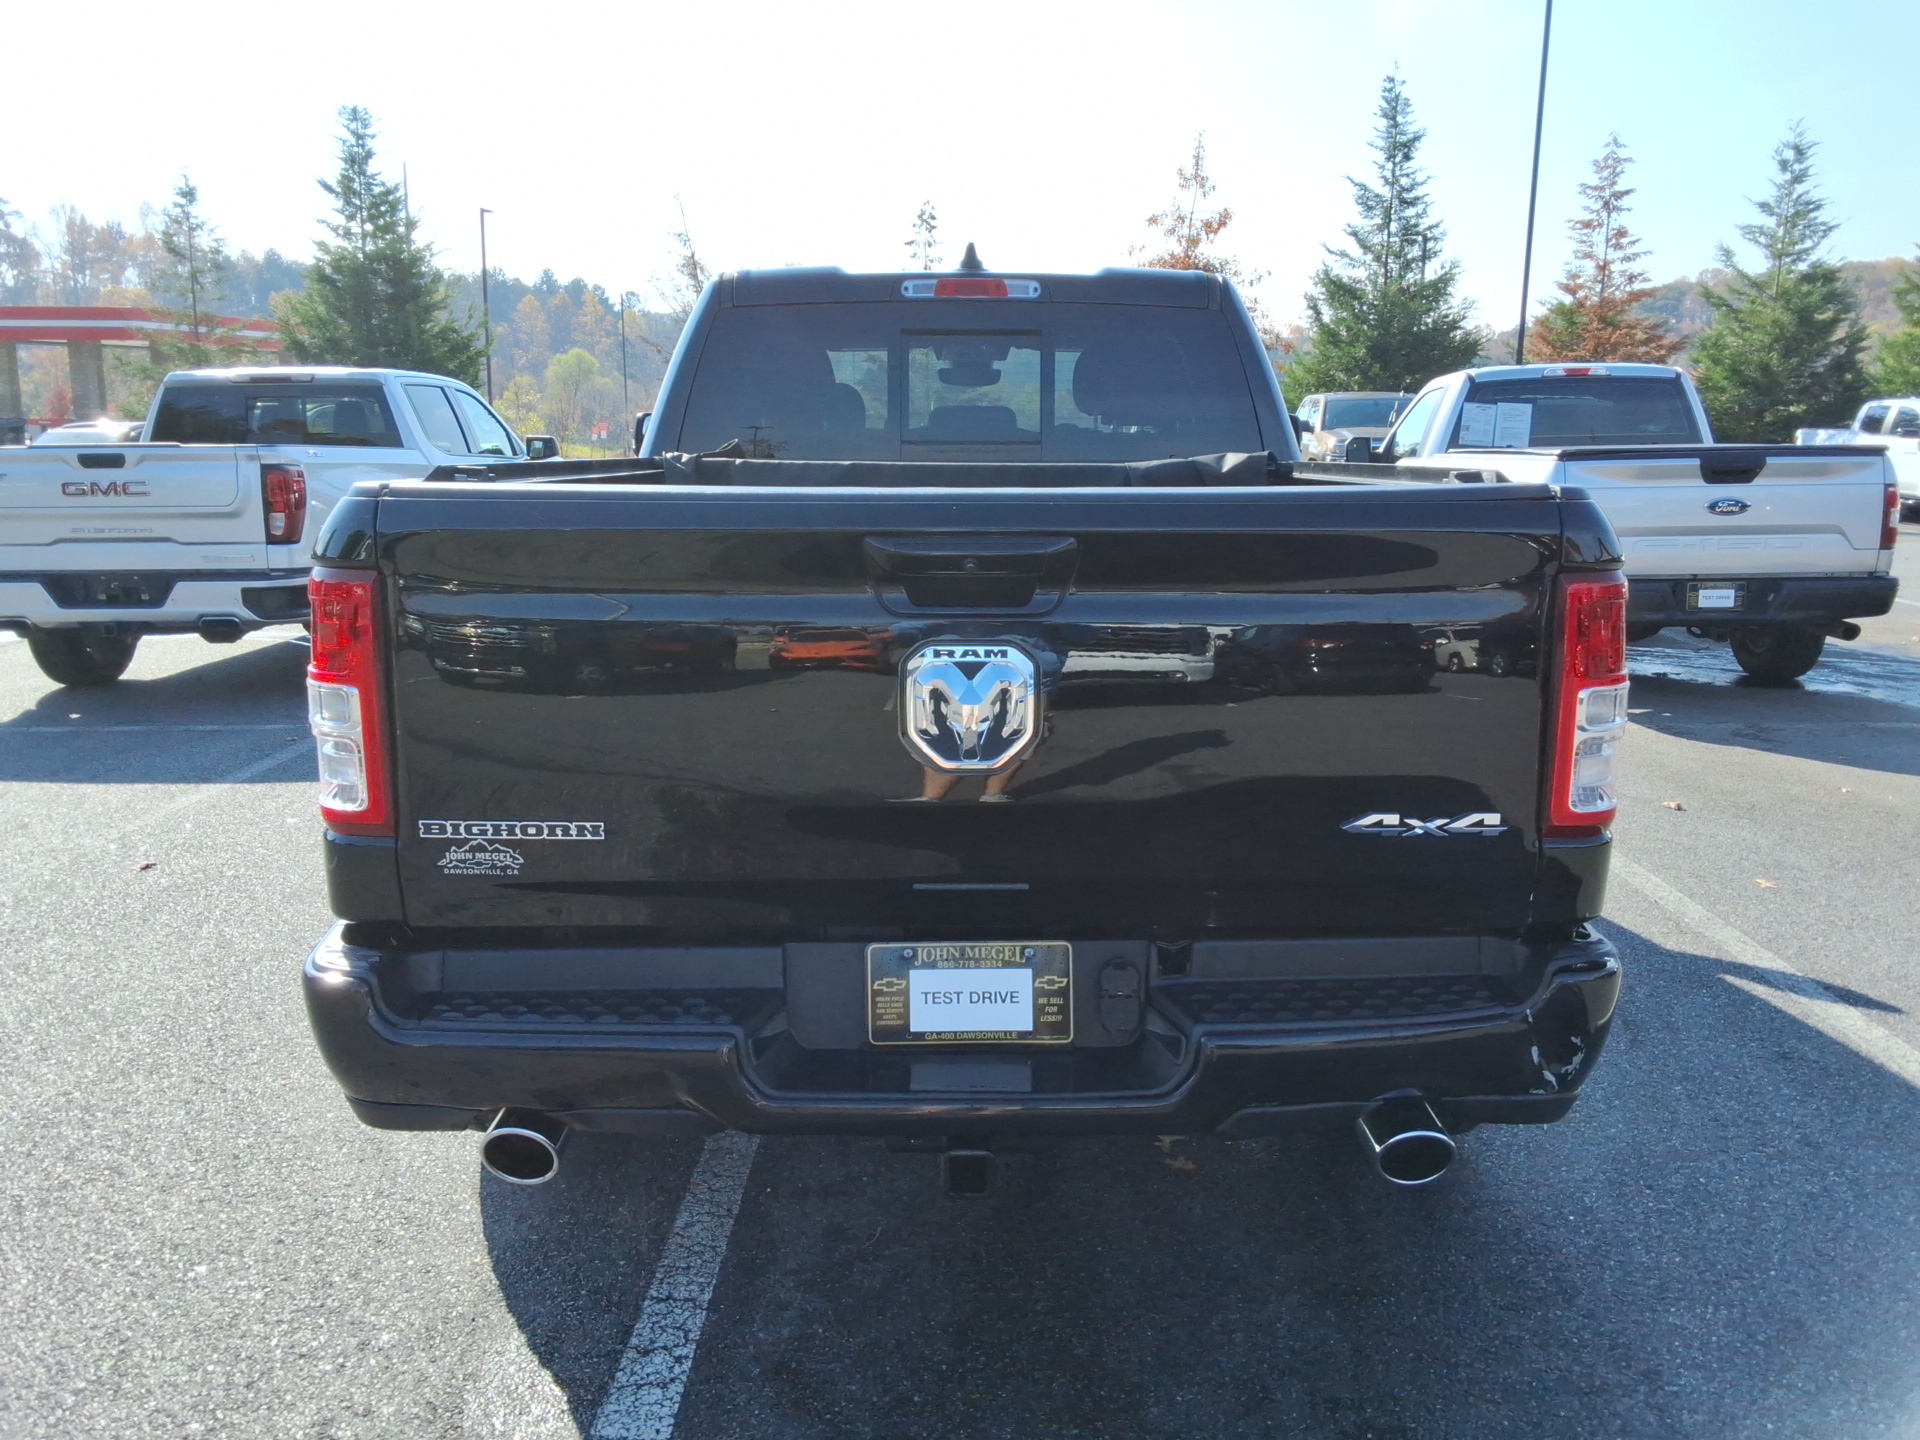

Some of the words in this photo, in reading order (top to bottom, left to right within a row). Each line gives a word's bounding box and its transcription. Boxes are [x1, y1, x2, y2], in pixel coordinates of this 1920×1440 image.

[61, 480, 150, 497] GMC
[1633, 537, 1809, 552] F-150
[933, 649, 1008, 658] RAM
[418, 820, 605, 839] BIGHORN
[1340, 812, 1508, 836] 4x4
[445, 852, 473, 863] JOHN
[474, 852, 514, 862] MEGEL
[444, 868, 504, 876] DAWSONVILLE,
[914, 947, 959, 966] JOHN
[964, 946, 1026, 963] MEGEL
[937, 960, 1002, 968] 866-778-3334
[921, 991, 964, 1005] TEST
[969, 990, 1020, 1005] DRIVE
[956, 1031, 1018, 1039] DAWSONVILLE
